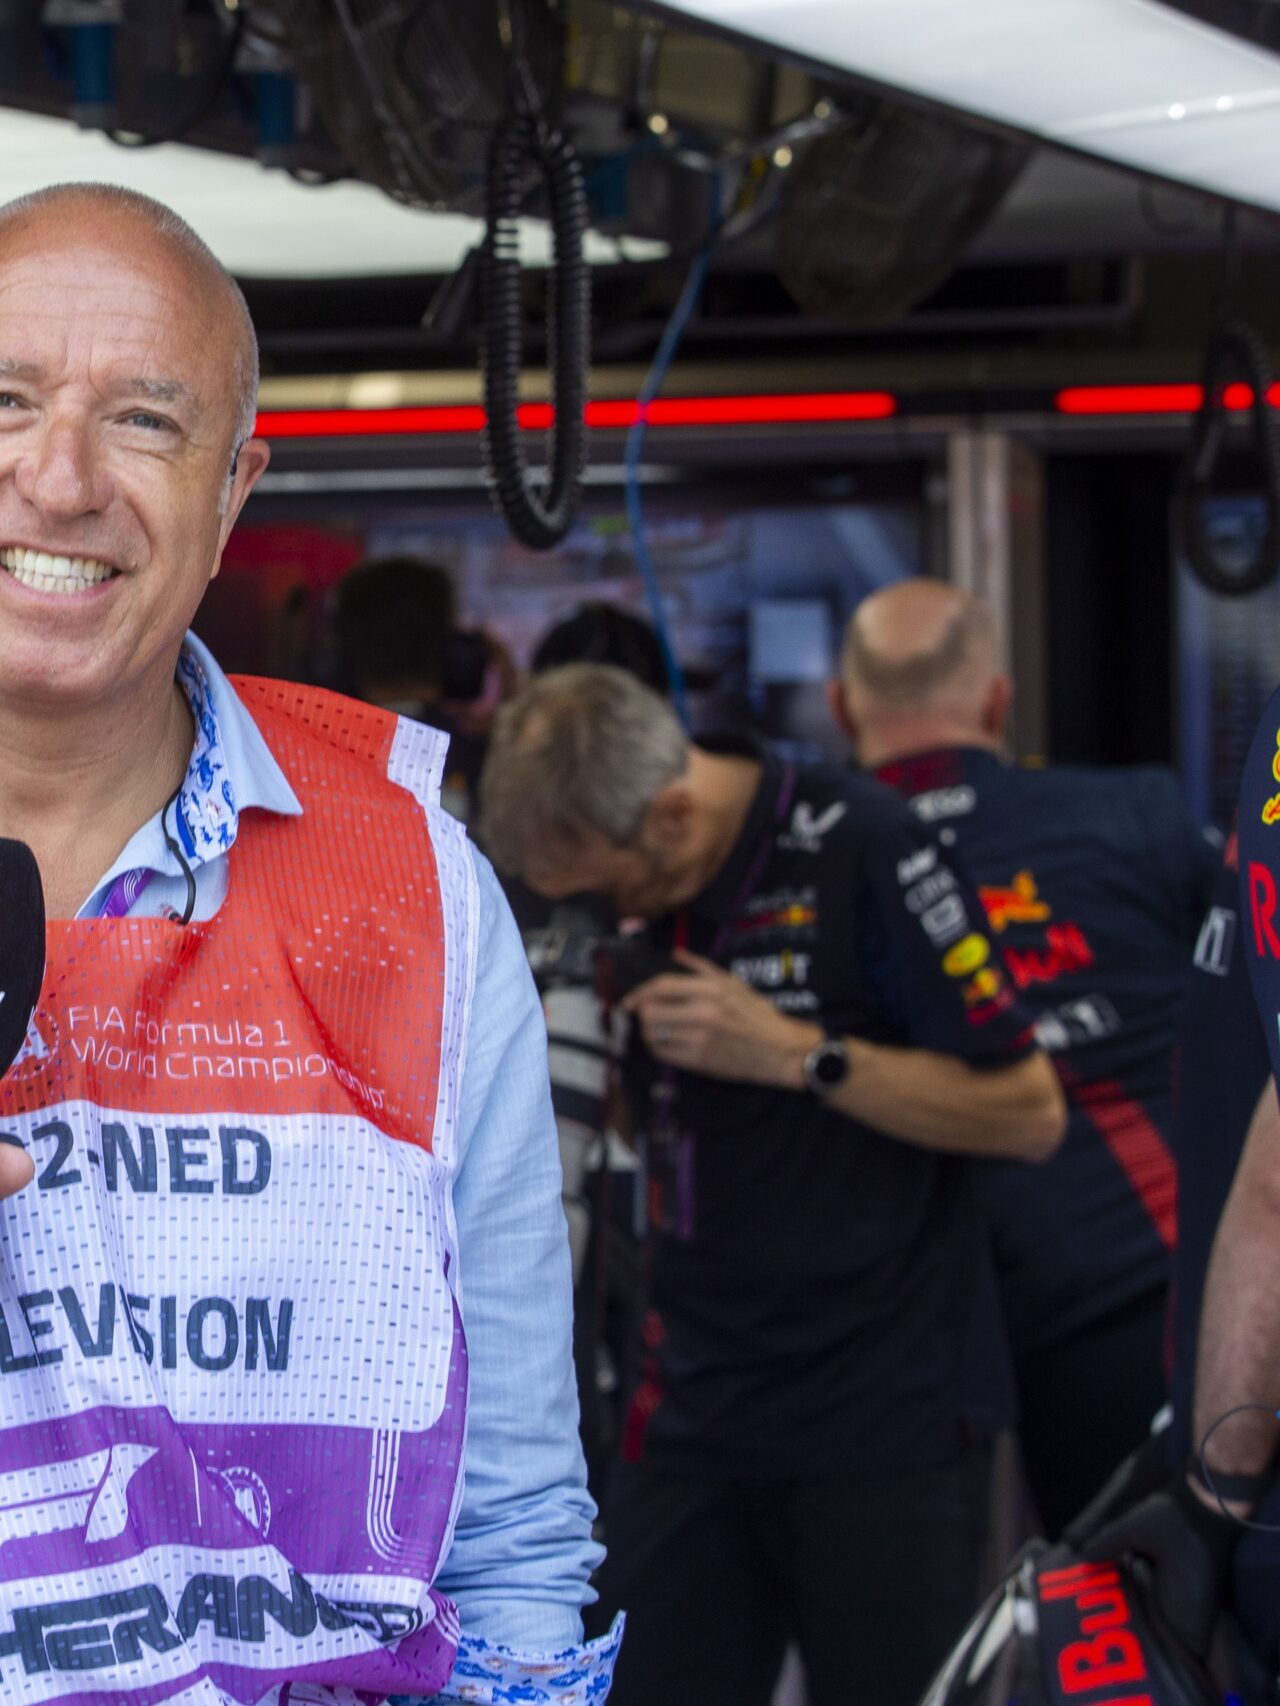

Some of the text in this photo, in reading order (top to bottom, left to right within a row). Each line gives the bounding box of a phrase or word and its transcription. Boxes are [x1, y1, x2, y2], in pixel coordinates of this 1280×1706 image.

[68, 1006, 293, 1048] FIA Formula 1
[70, 1037, 157, 1080] World
[1037, 1560, 1148, 1694] Bull
